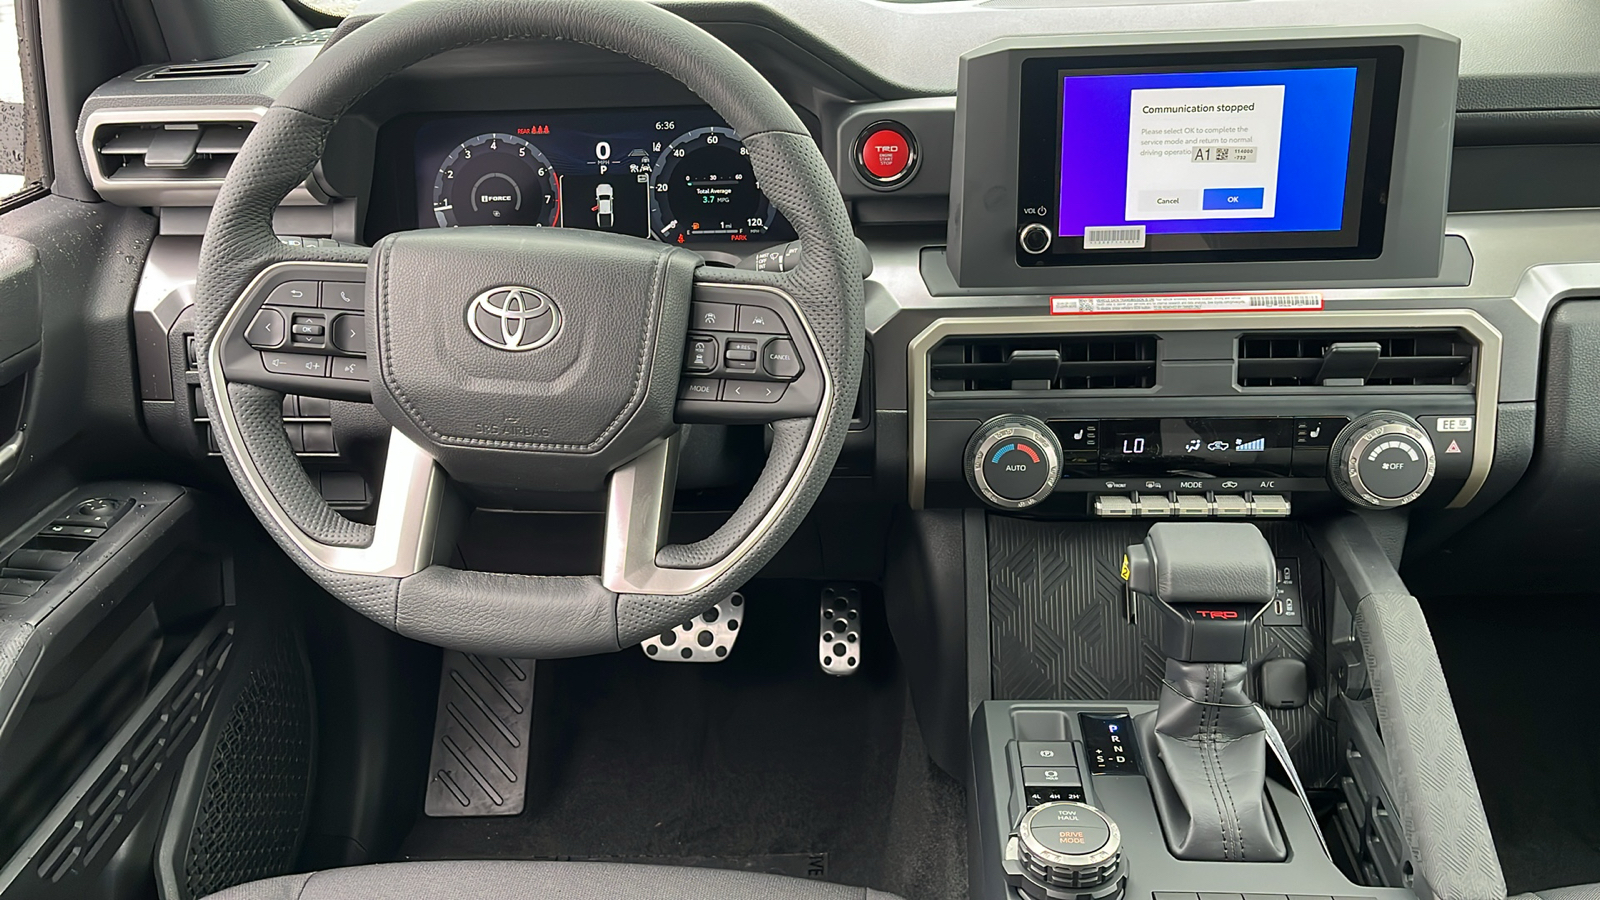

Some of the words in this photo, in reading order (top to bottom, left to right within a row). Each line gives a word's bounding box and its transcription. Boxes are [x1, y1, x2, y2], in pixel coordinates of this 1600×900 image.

[1142, 105, 1214, 115] Communication
[1216, 103, 1255, 114] stopped
[655, 121, 675, 130] 6:36
[1204, 126, 1236, 136] complete
[707, 136, 718, 144] 60
[490, 142, 497, 150] 4
[465, 150, 472, 159] 3
[519, 148, 526, 157] 5
[596, 142, 611, 160] 0
[673, 149, 685, 157] 40
[1140, 149, 1162, 158] driving
[1194, 148, 1210, 160] A1
[538, 168, 544, 176] 6
[600, 166, 608, 174] P
[656, 184, 668, 192] 20
[544, 195, 551, 204] 7
[747, 218, 762, 227] 120
[1443, 420, 1455, 430] EE
[502, 426, 550, 438] AIRBAG
[1123, 438, 1145, 453] LO
[1196, 610, 1238, 619] TRD
[1109, 724, 1118, 733] P
